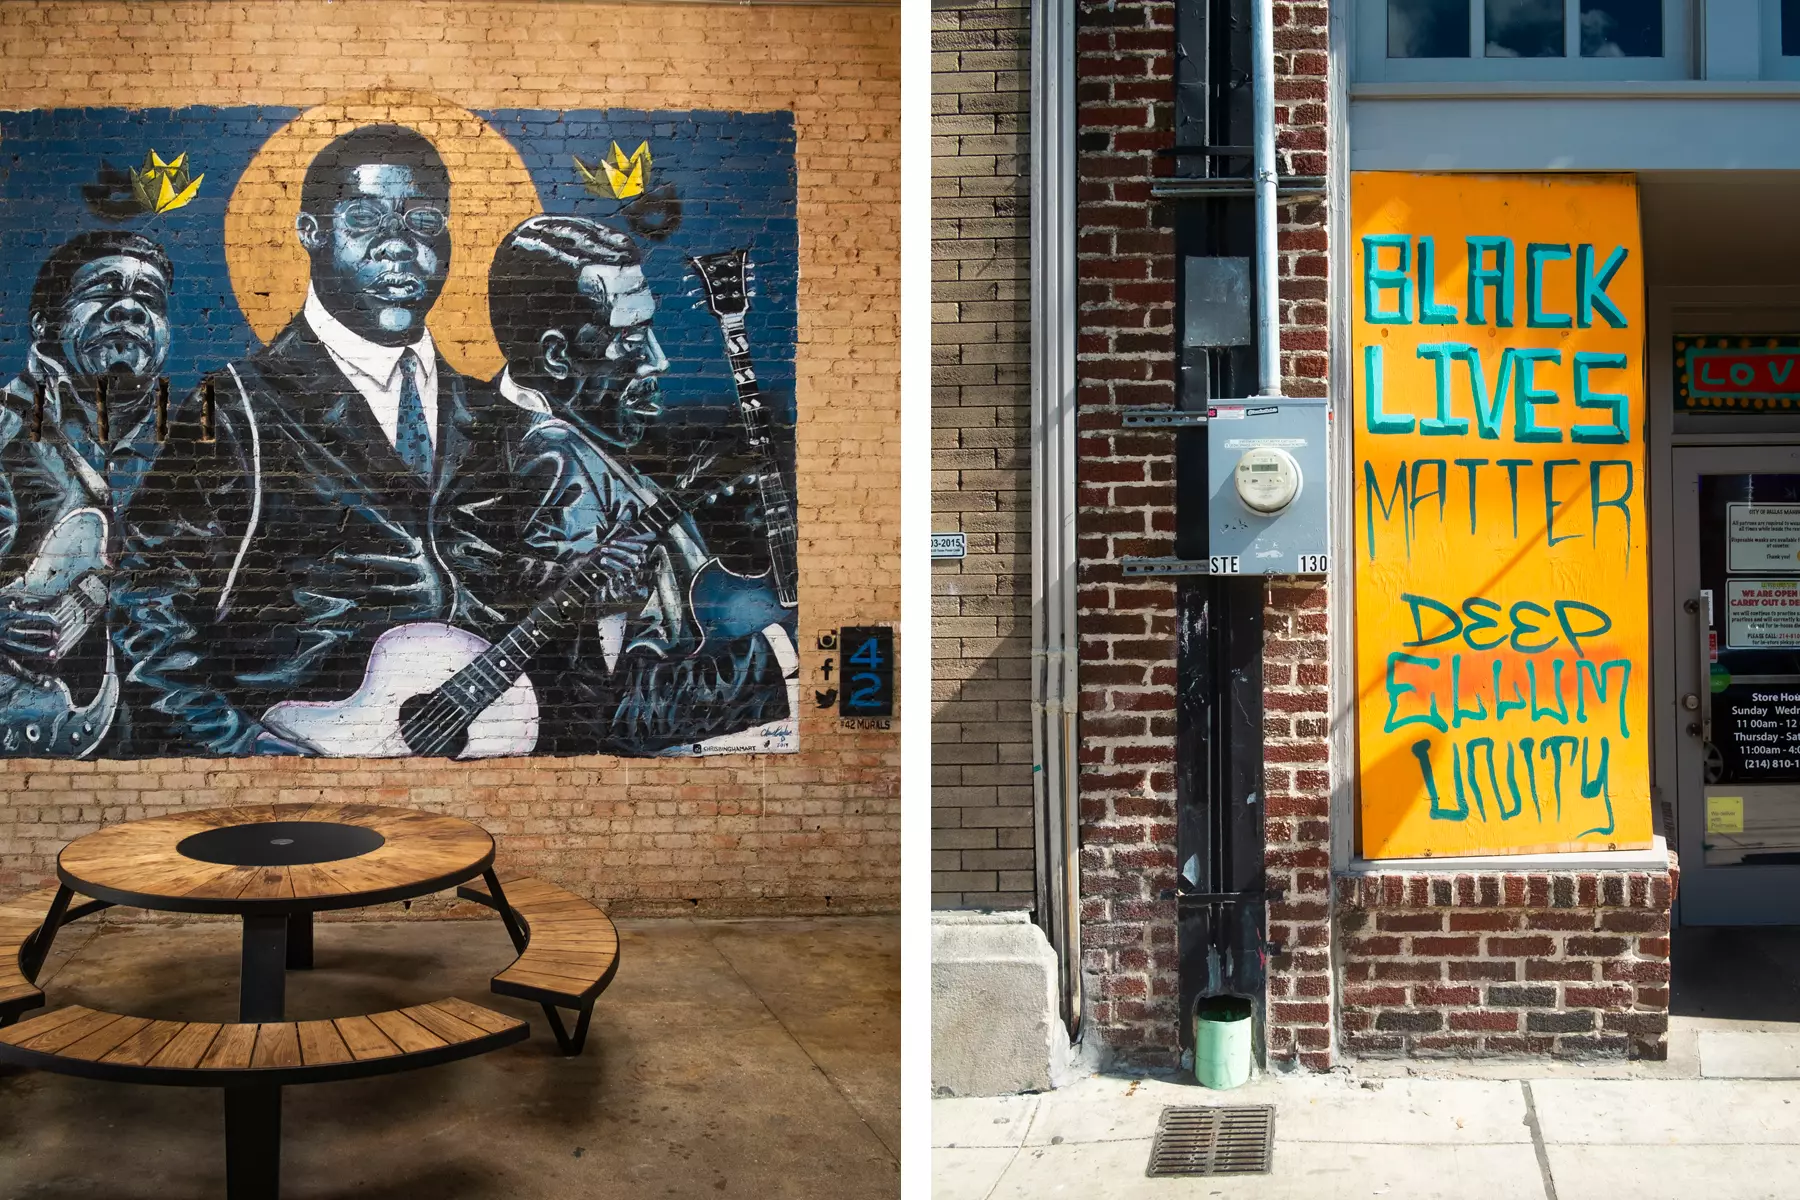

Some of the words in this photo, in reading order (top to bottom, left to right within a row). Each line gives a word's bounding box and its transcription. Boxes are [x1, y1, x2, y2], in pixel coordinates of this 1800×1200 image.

[1361, 234, 1628, 328] BLACK
[1364, 342, 1629, 444] LIVES
[1364, 459, 1633, 578] MATTER
[1211, 555, 1238, 573] STE
[1300, 555, 1327, 573] 130
[1401, 593, 1612, 658] DEEP
[1384, 652, 1631, 738] ELLUM
[1752, 692, 1779, 702] Store
[1731, 705, 1768, 717] Sunday
[857, 720, 890, 730] MURALS
[1786, 719, 1798, 728] 12
[1733, 732, 1779, 743] Thursday
[1739, 745, 1781, 754] 11:00am
[1745, 759, 1770, 770] (214)
[1411, 735, 1614, 839] UNITY
